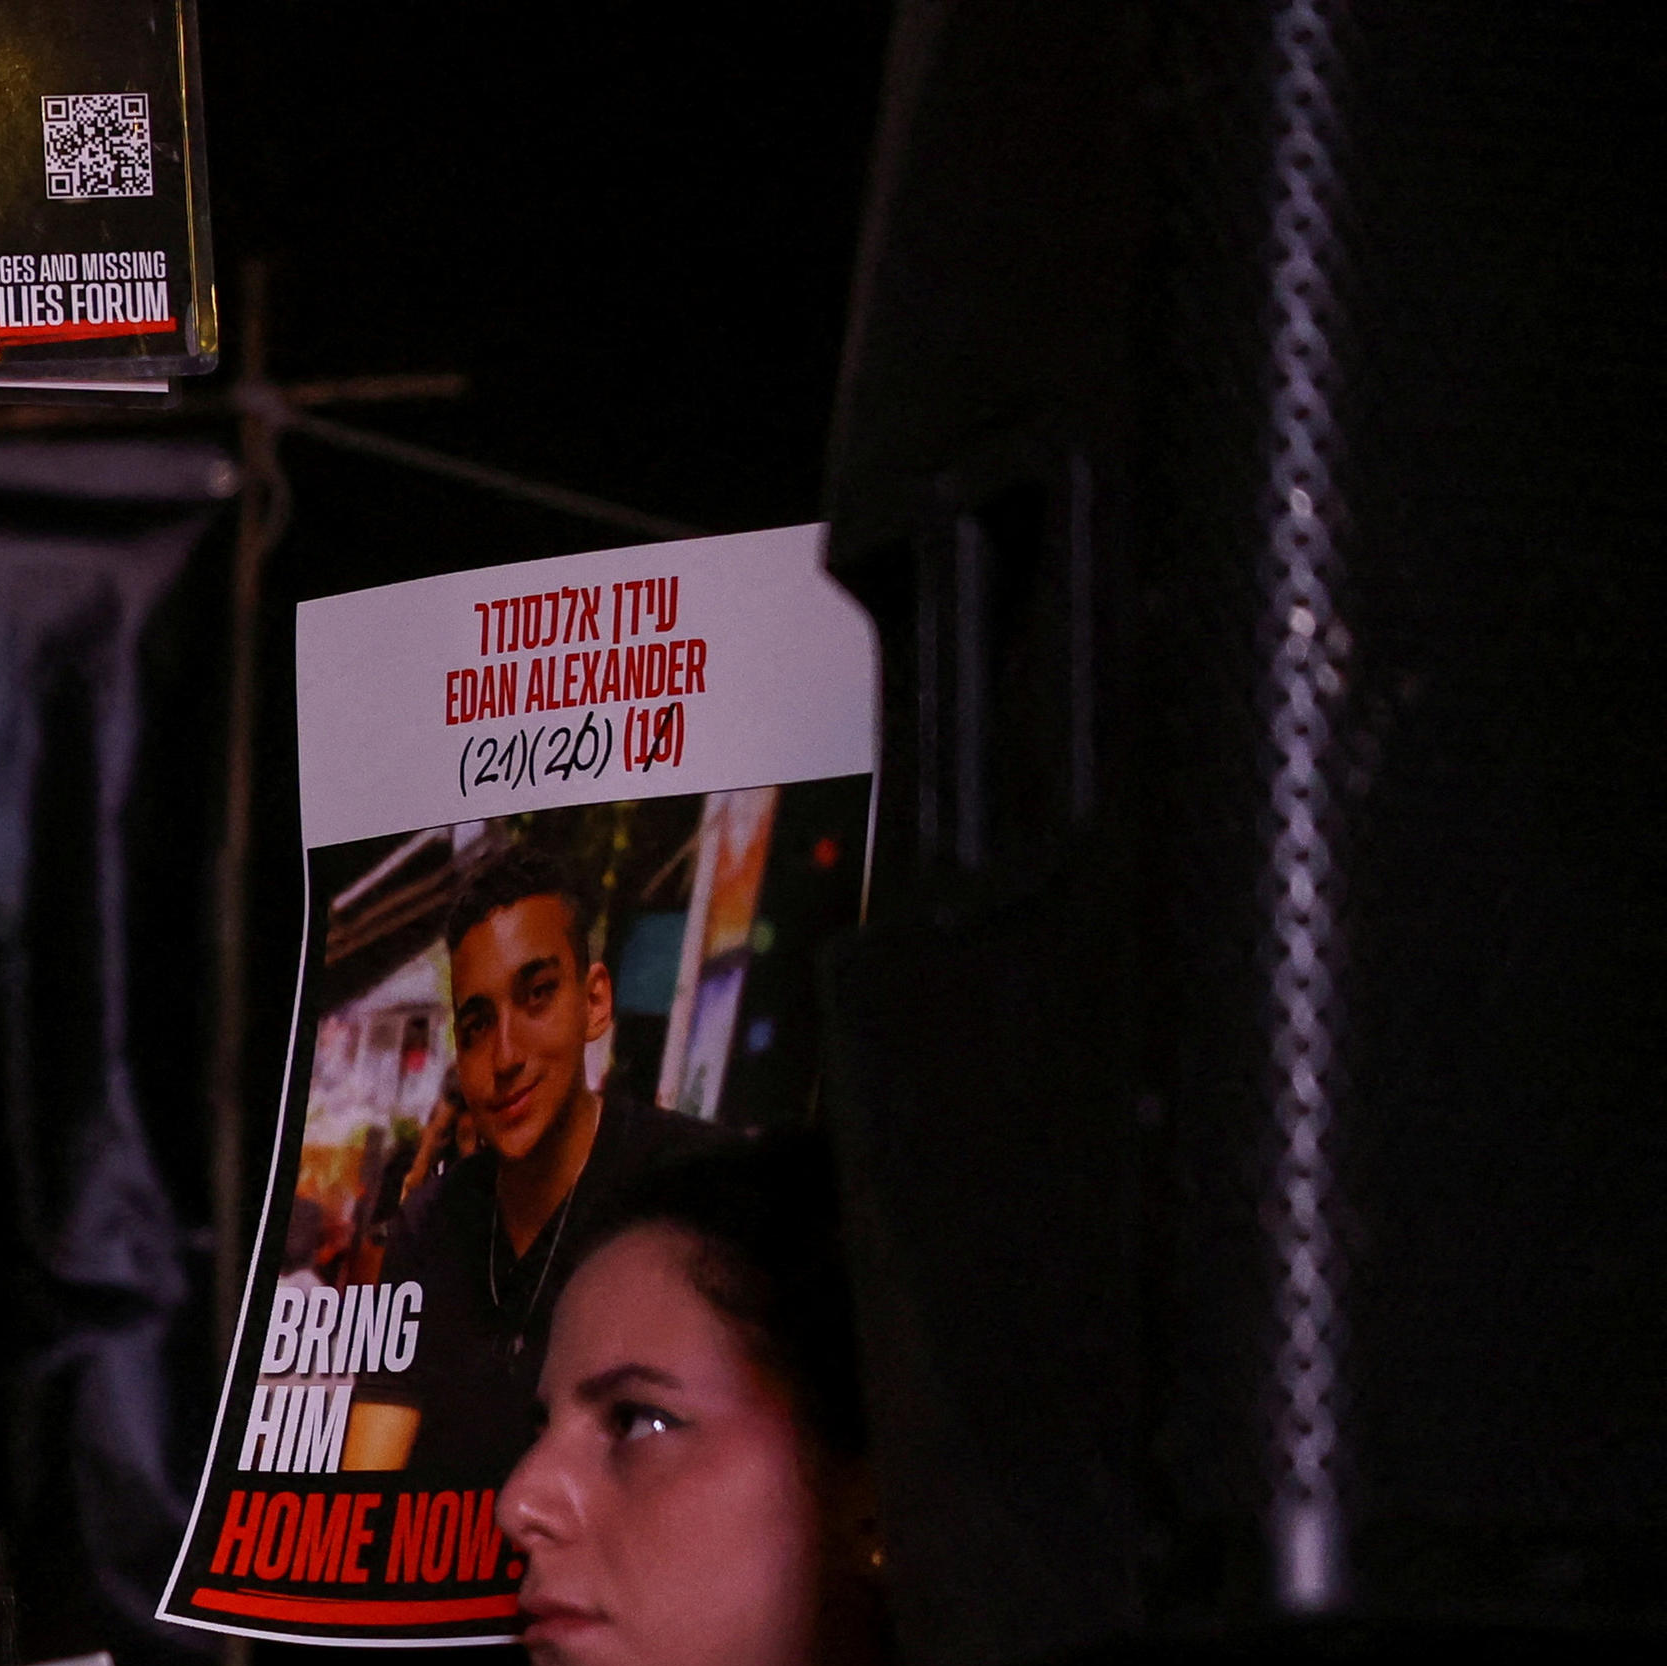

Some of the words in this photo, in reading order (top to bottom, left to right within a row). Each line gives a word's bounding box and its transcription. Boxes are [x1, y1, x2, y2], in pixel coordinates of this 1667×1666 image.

[40, 253, 77, 282] AND
[81, 250, 166, 281] MISSING
[70, 281, 169, 325] FORUM
[474, 585, 601, 656] אלכסנדר
[612, 575, 679, 645] עידן
[446, 666, 517, 726] EDAN
[524, 638, 707, 713] ALEXANDER
[259, 1280, 424, 1375] BRING
[237, 1384, 353, 1474] HIM
[210, 1488, 384, 1584] HOME
